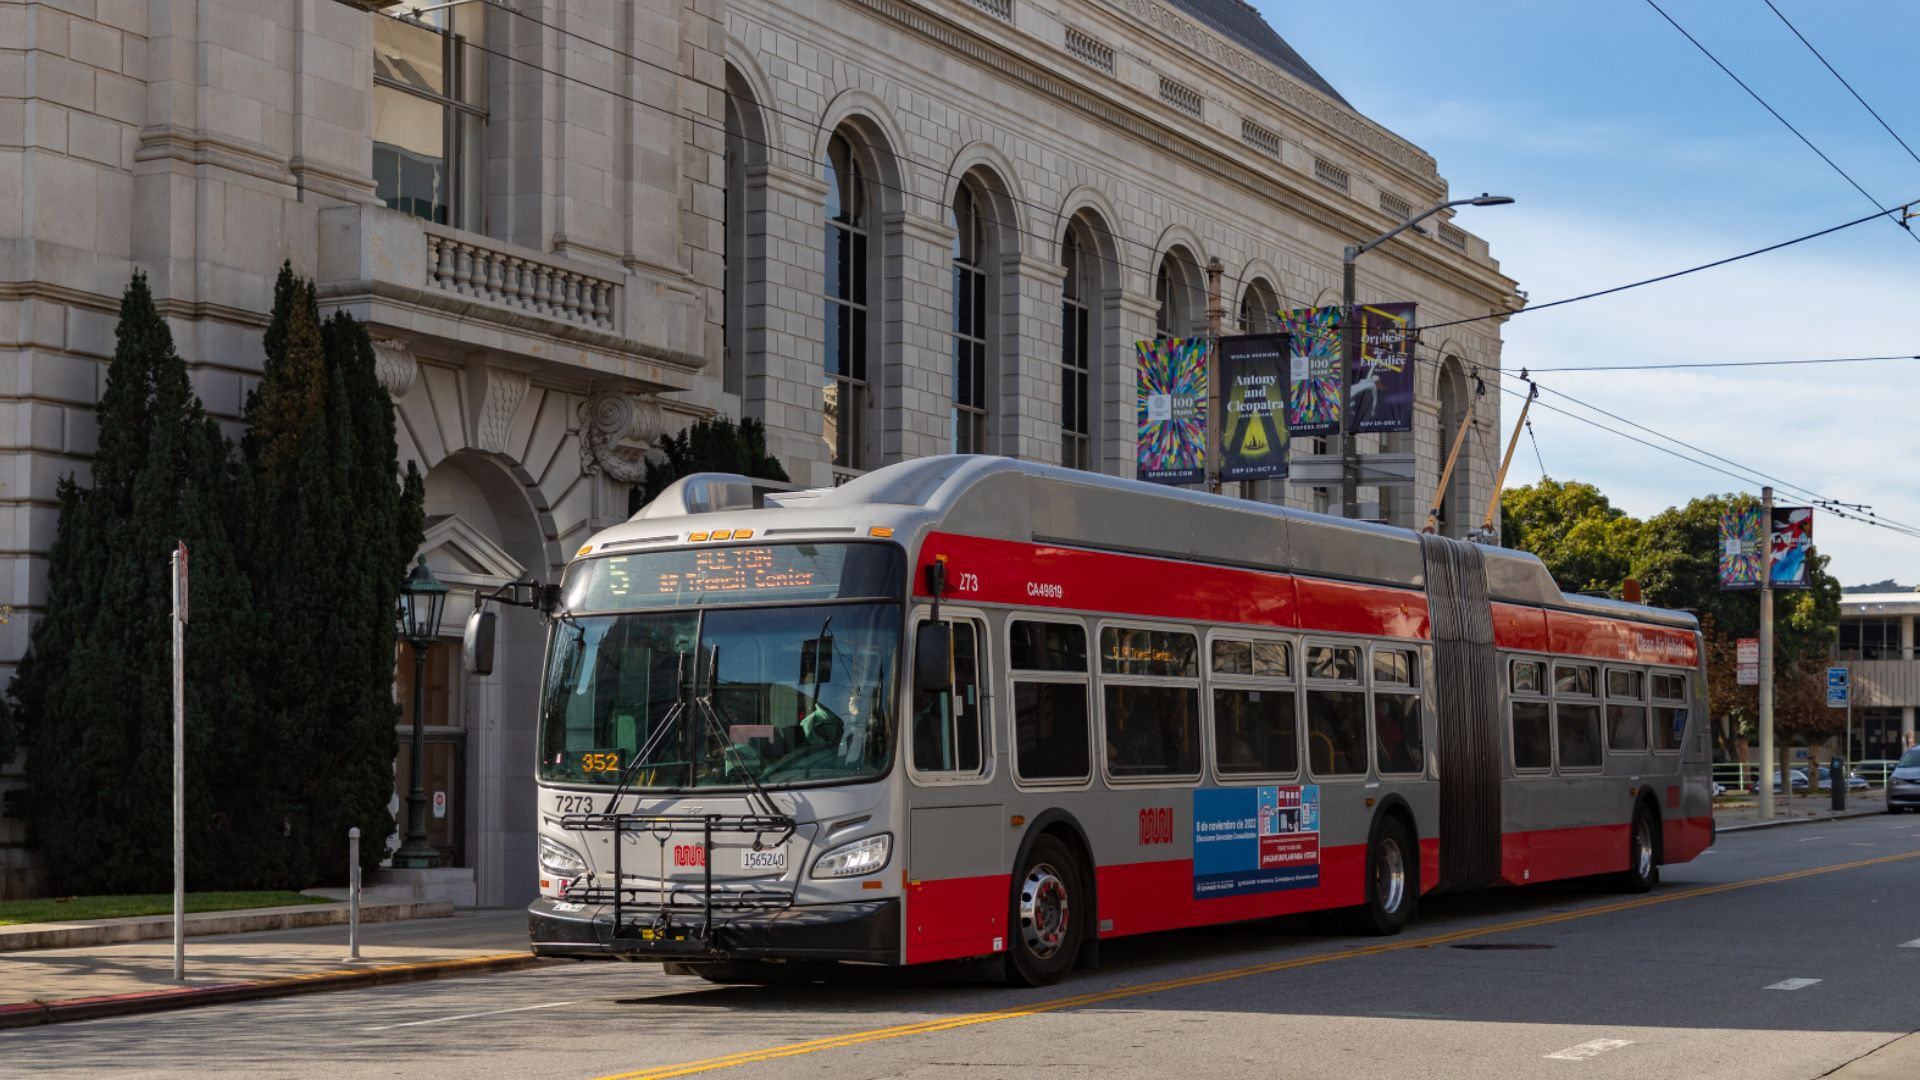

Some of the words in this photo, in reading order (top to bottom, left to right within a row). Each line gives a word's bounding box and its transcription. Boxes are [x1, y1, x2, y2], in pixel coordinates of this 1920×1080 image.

[1310, 359, 1328, 368] 100
[1234, 375, 1277, 386] Antony
[1244, 386, 1266, 398] and
[1173, 397, 1194, 408] 100
[1227, 400, 1285, 414] Cleopatra
[696, 549, 772, 570] FULTON
[609, 557, 629, 594] 5
[1026, 581, 1063, 599] CA49819
[581, 752, 619, 773] 352
[555, 795, 594, 814] 7273
[1201, 821, 1208, 831] de
[1208, 819, 1236, 831] noviembre
[1236, 818, 1244, 830] de
[1244, 818, 1257, 829] 2022
[744, 852, 784, 866] 1565240
